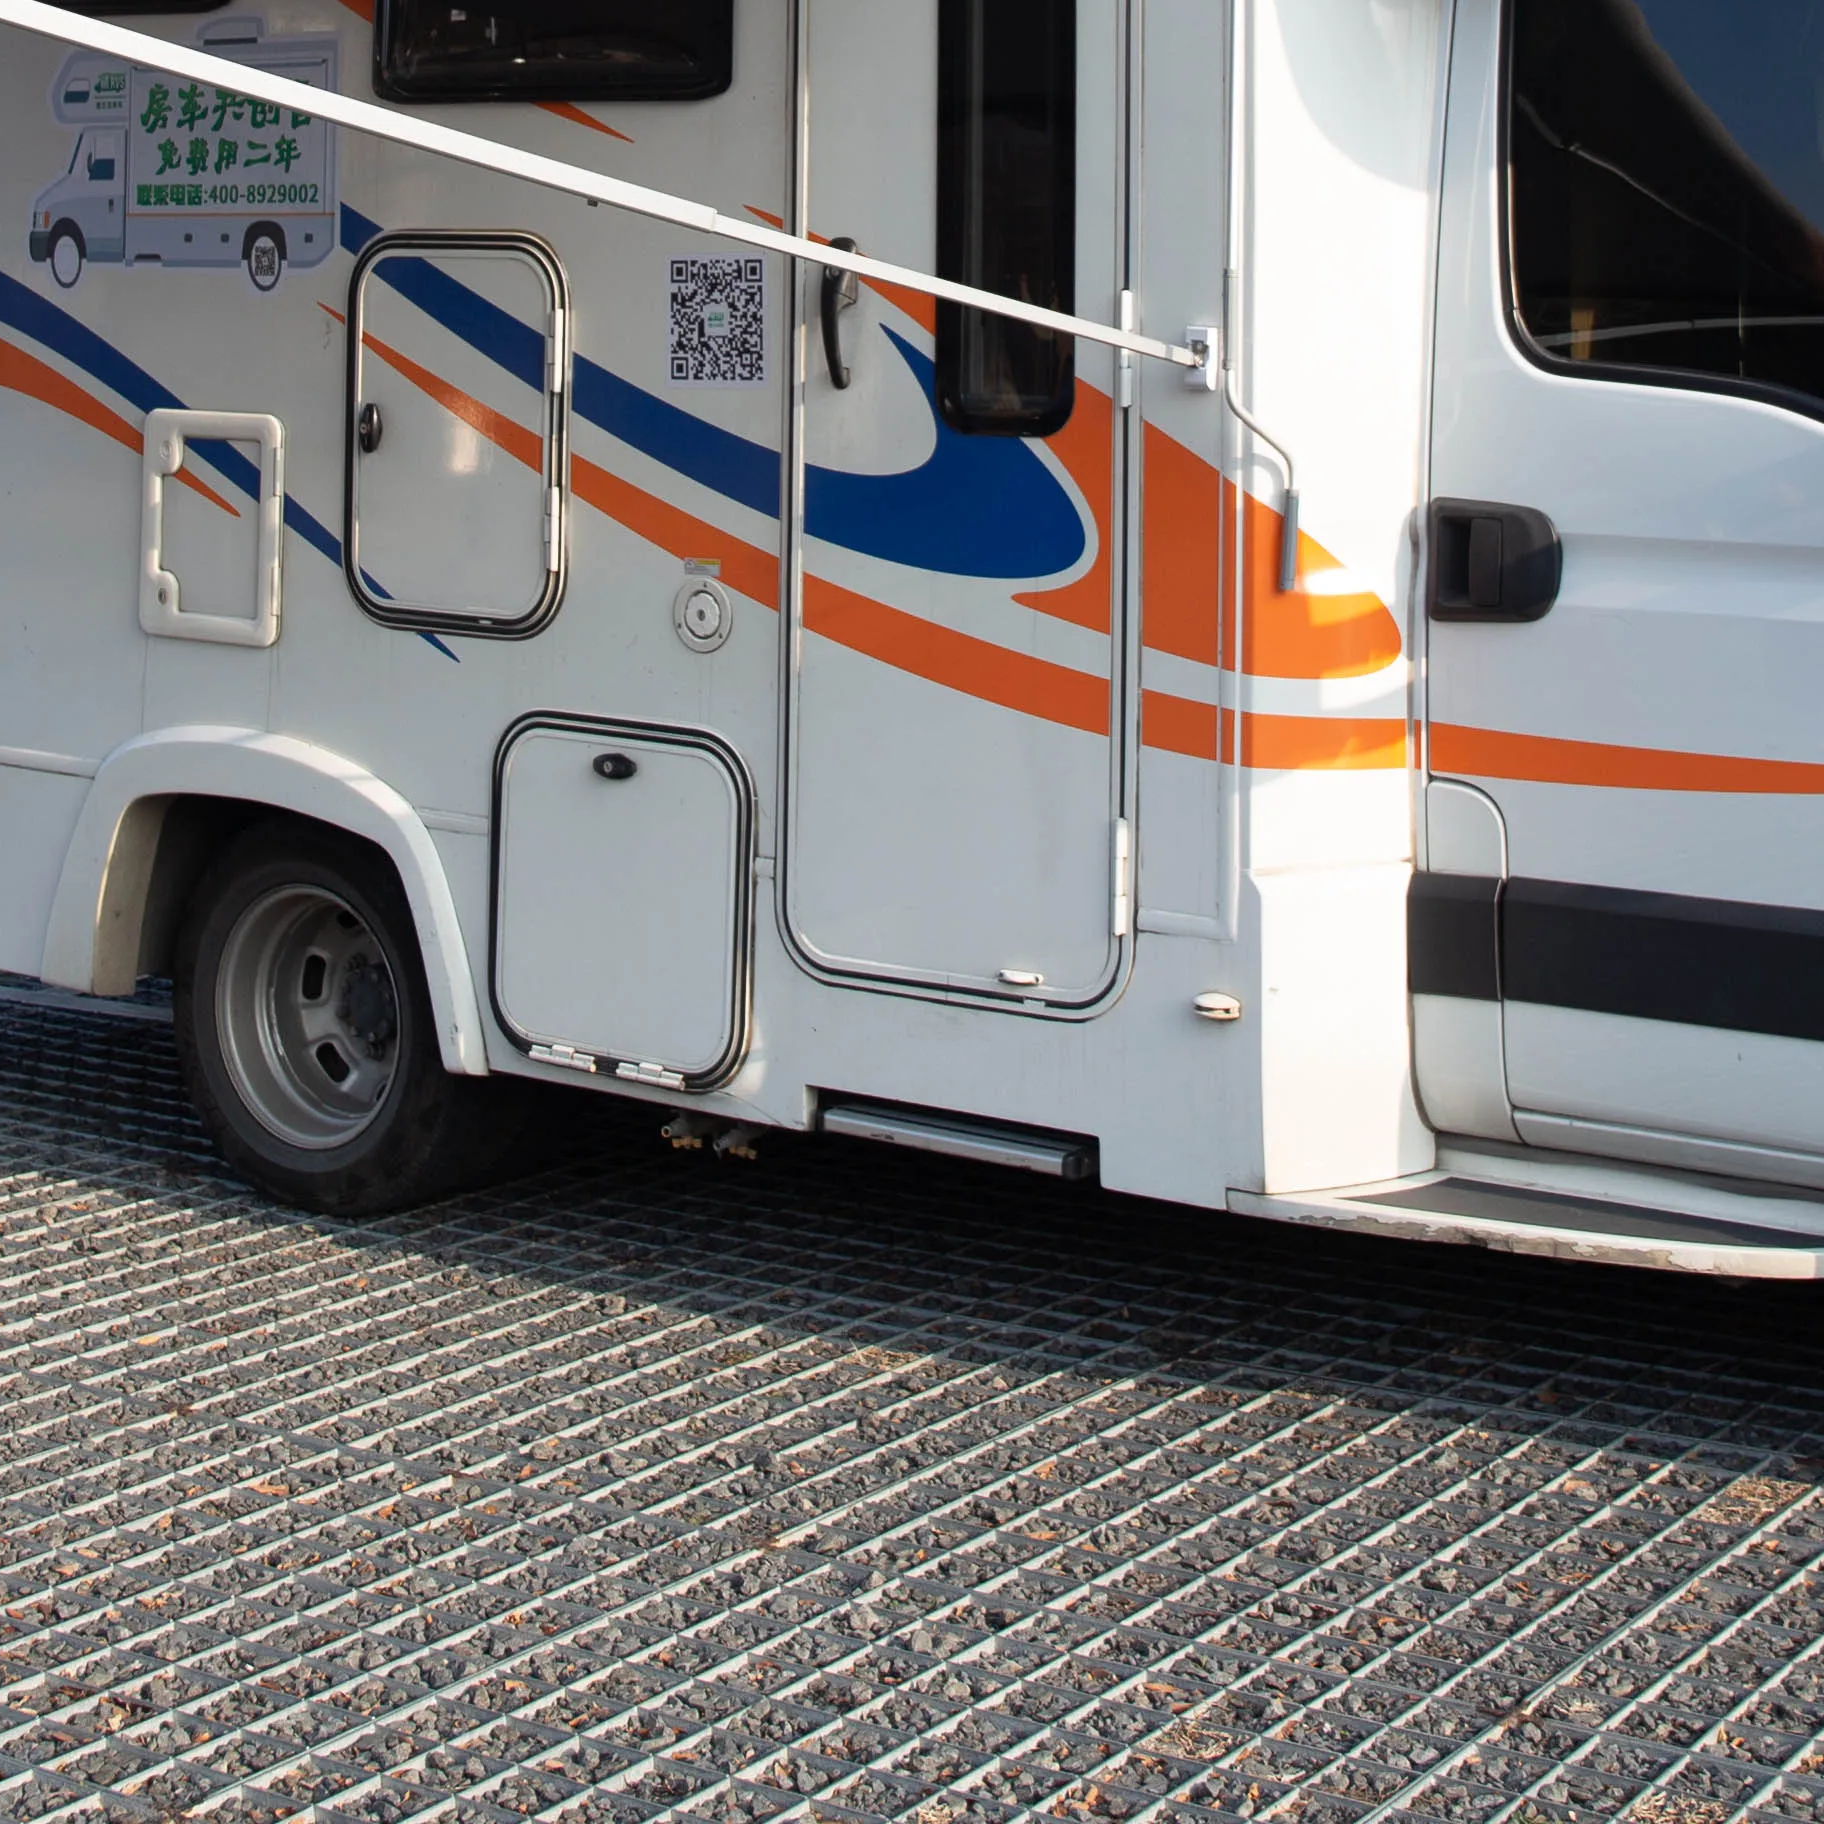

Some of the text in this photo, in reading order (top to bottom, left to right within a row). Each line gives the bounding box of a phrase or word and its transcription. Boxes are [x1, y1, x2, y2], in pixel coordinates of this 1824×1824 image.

[139, 78, 314, 134] 房车共创
[155, 133, 302, 176] 免费用二年
